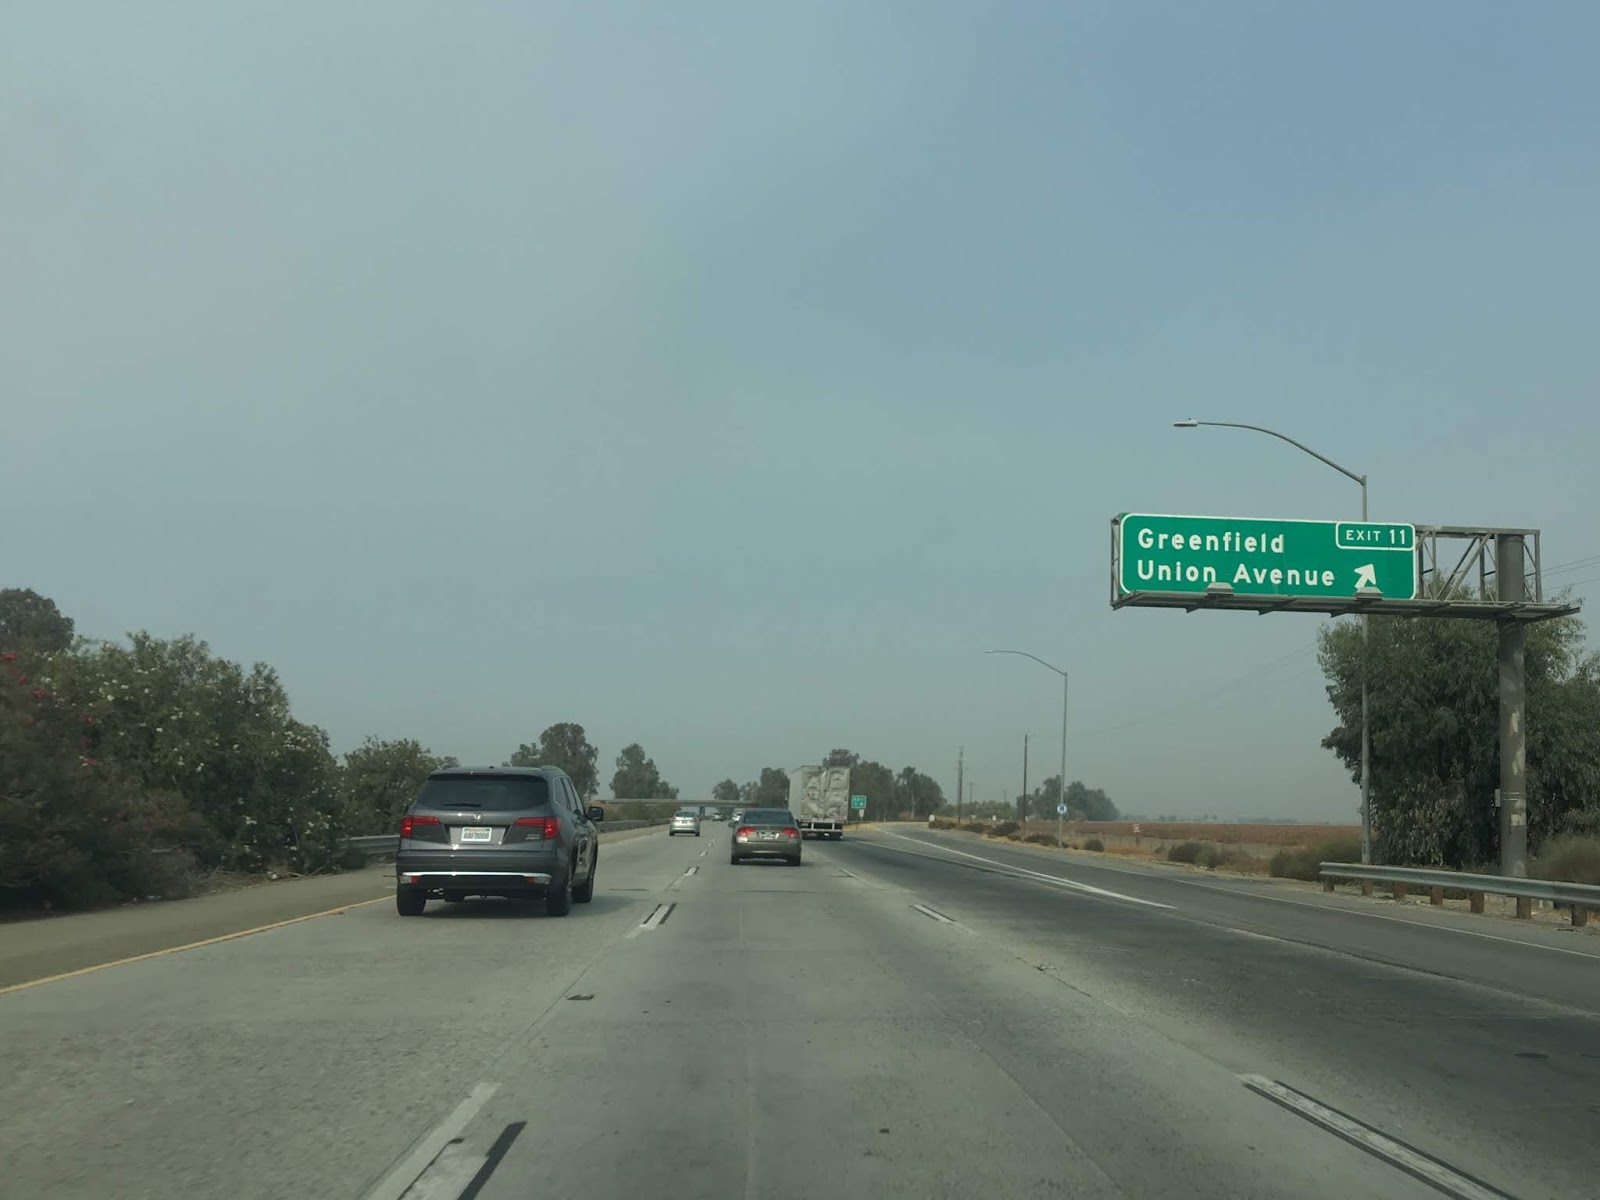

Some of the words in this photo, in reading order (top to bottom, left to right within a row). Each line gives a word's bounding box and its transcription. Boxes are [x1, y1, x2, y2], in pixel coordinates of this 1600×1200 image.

[1137, 528, 1284, 553] Greenfield
[1345, 529, 1381, 542] EXIT
[1389, 528, 1406, 545] 11
[1137, 559, 1217, 583] Union
[1232, 563, 1335, 587] Avenue
